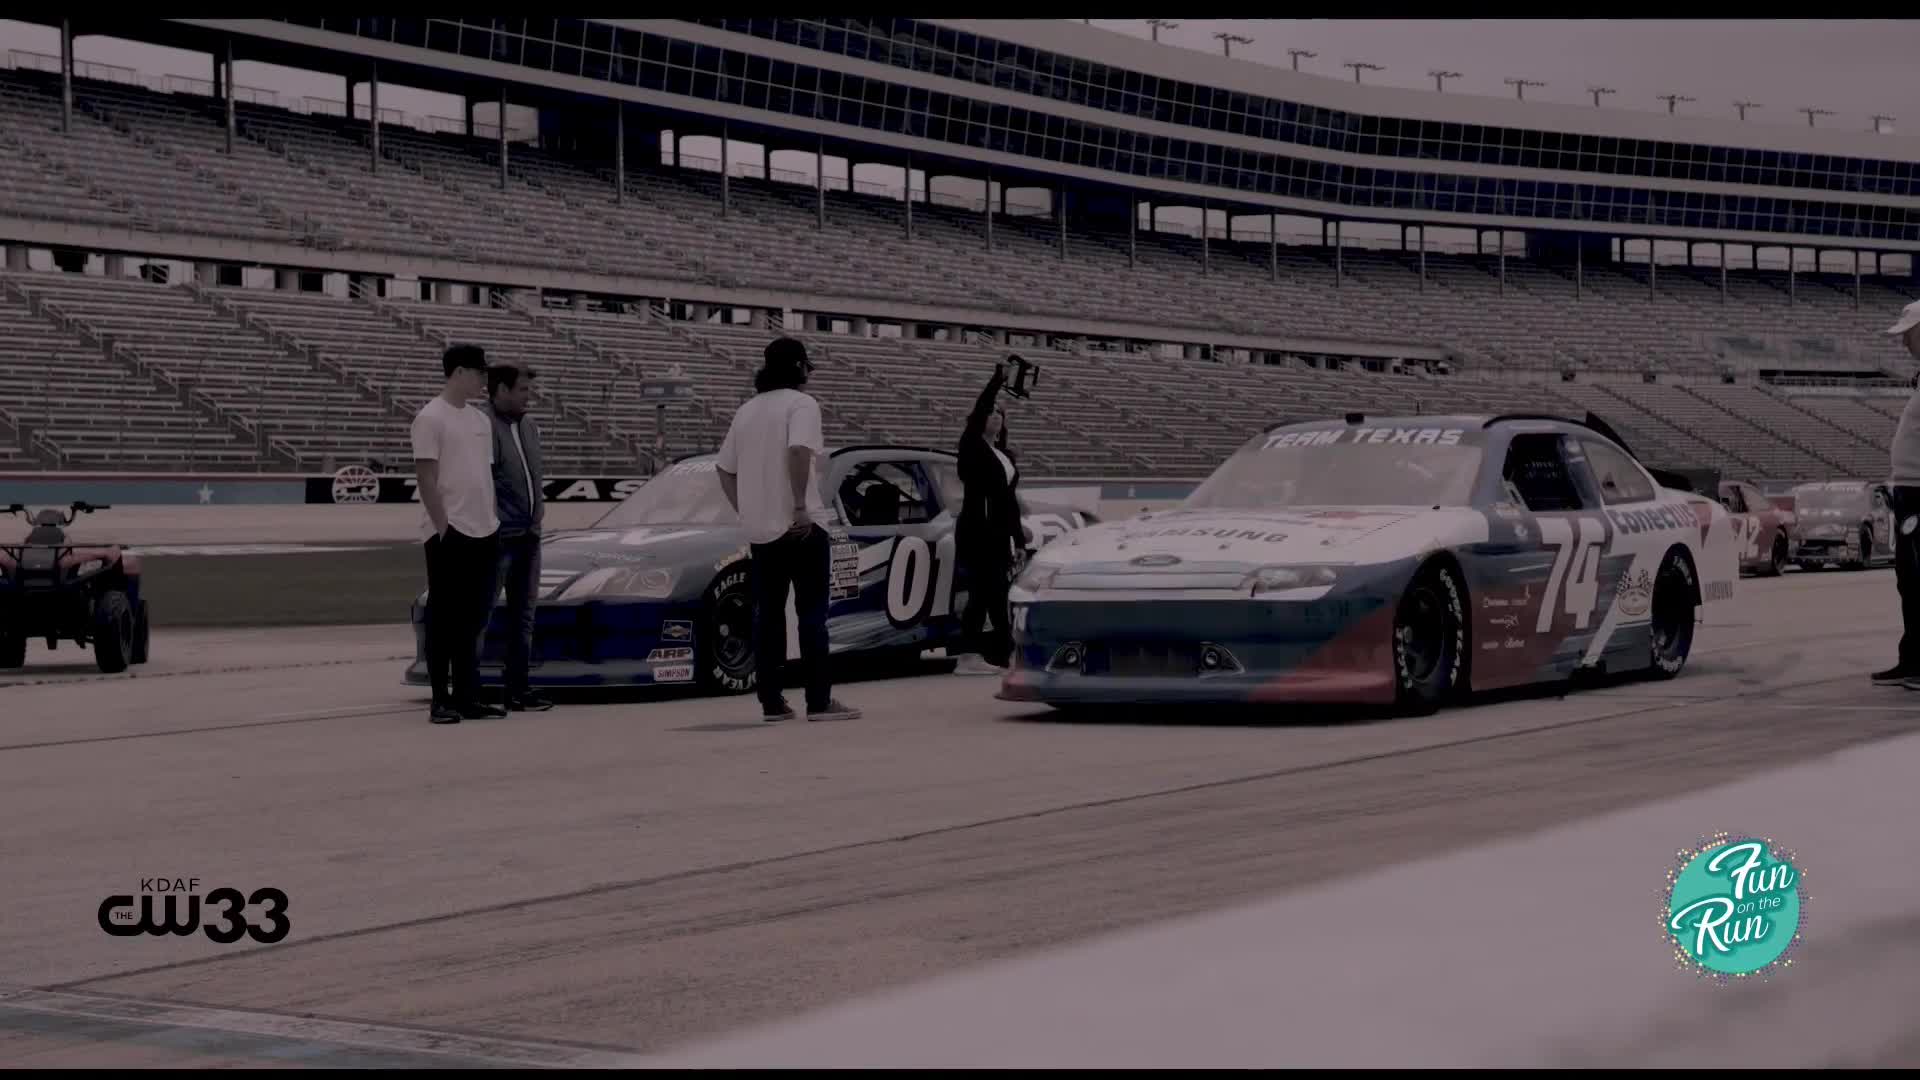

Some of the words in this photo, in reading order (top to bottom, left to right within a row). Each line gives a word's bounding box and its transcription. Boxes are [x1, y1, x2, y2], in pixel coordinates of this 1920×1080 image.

[1262, 430, 1345, 449] TEAM
[1352, 428, 1465, 445] TEXAS
[714, 572, 747, 600] EAGLE
[887, 533, 957, 622] 01
[1534, 517, 1605, 633] 74
[651, 648, 692, 659] ARP
[657, 667, 690, 679] SIMPSON
